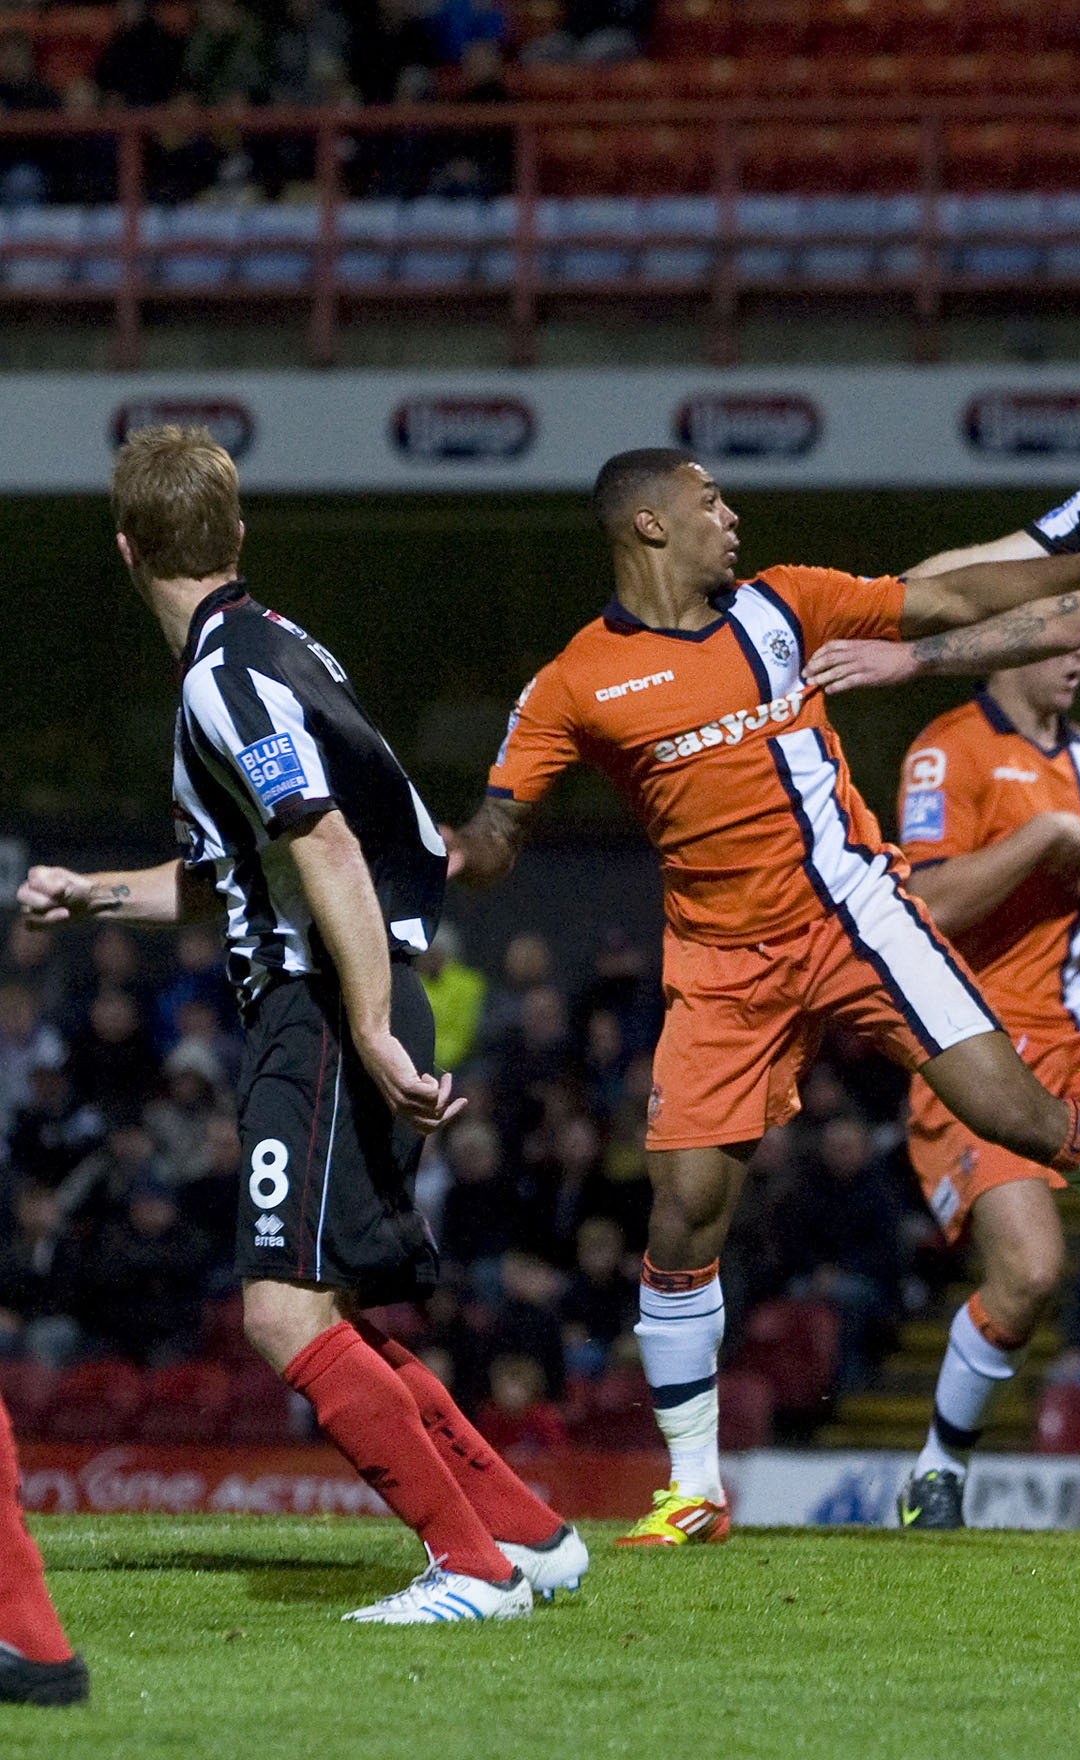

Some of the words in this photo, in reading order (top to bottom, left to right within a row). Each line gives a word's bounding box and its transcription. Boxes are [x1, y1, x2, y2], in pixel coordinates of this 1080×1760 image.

[241, 737, 293, 771] BLUE
[250, 760, 283, 788] SQ
[249, 1138, 289, 1209] 8
